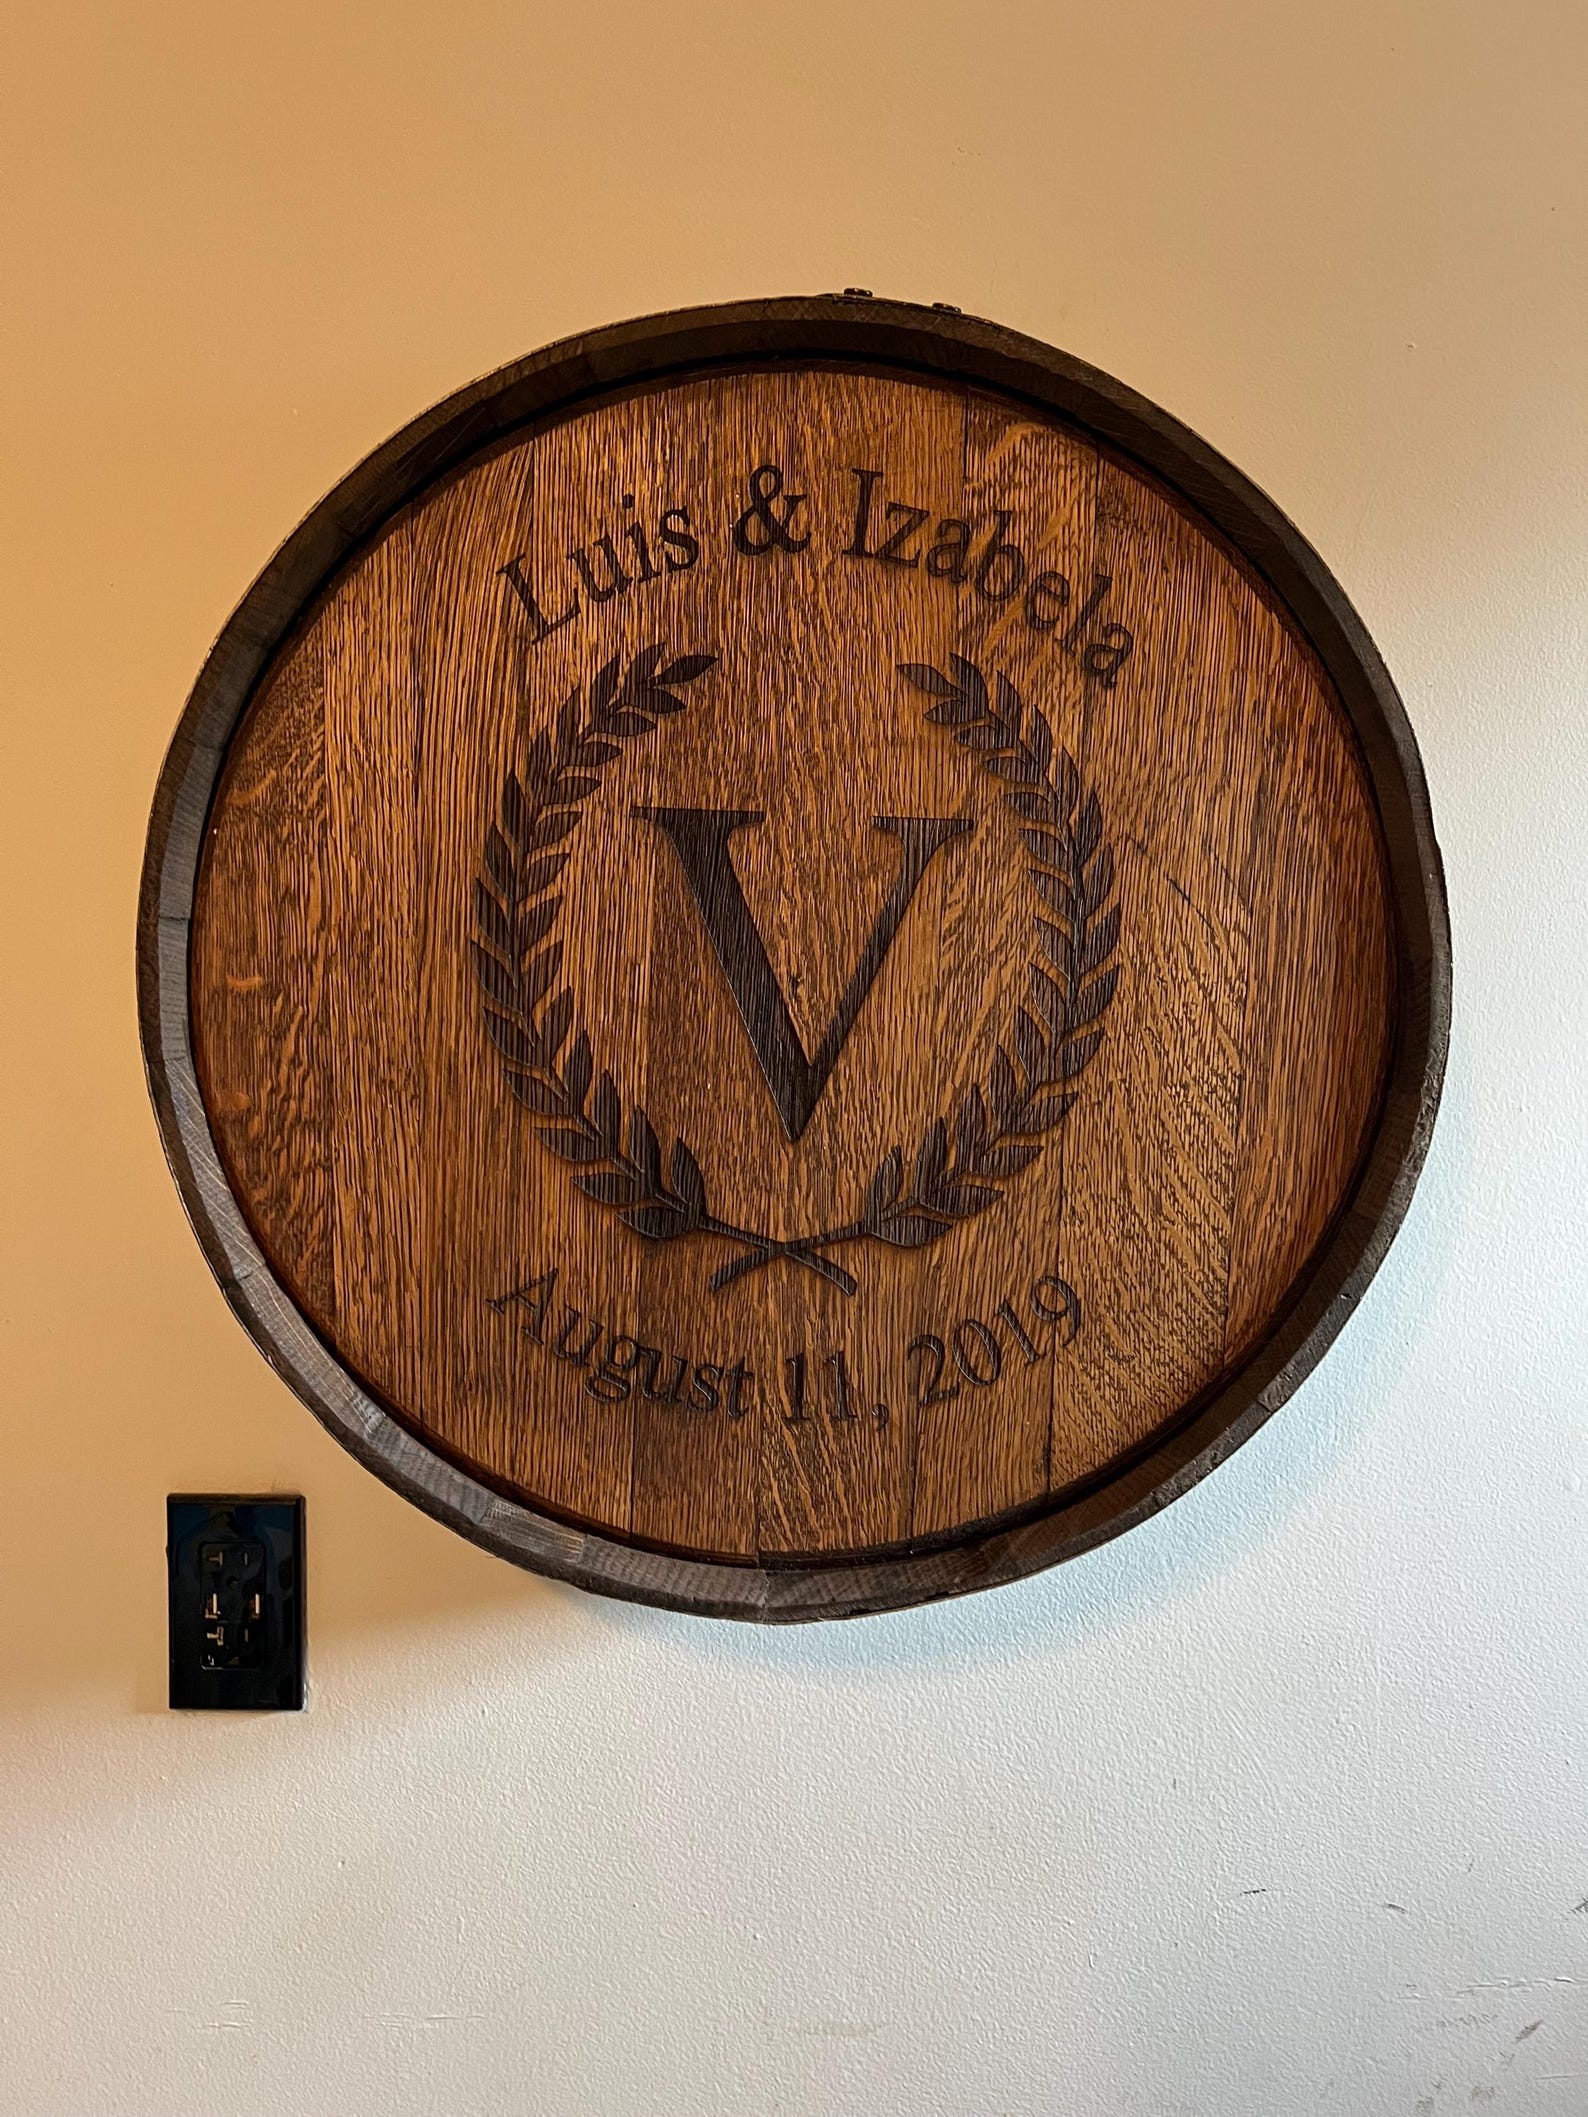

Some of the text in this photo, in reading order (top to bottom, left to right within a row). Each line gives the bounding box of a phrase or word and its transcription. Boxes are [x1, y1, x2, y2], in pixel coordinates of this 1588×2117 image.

[496, 465, 1133, 689] Luis & Izabela
[630, 806, 974, 1142] V
[486, 1267, 1081, 1432] August 11, 2019
